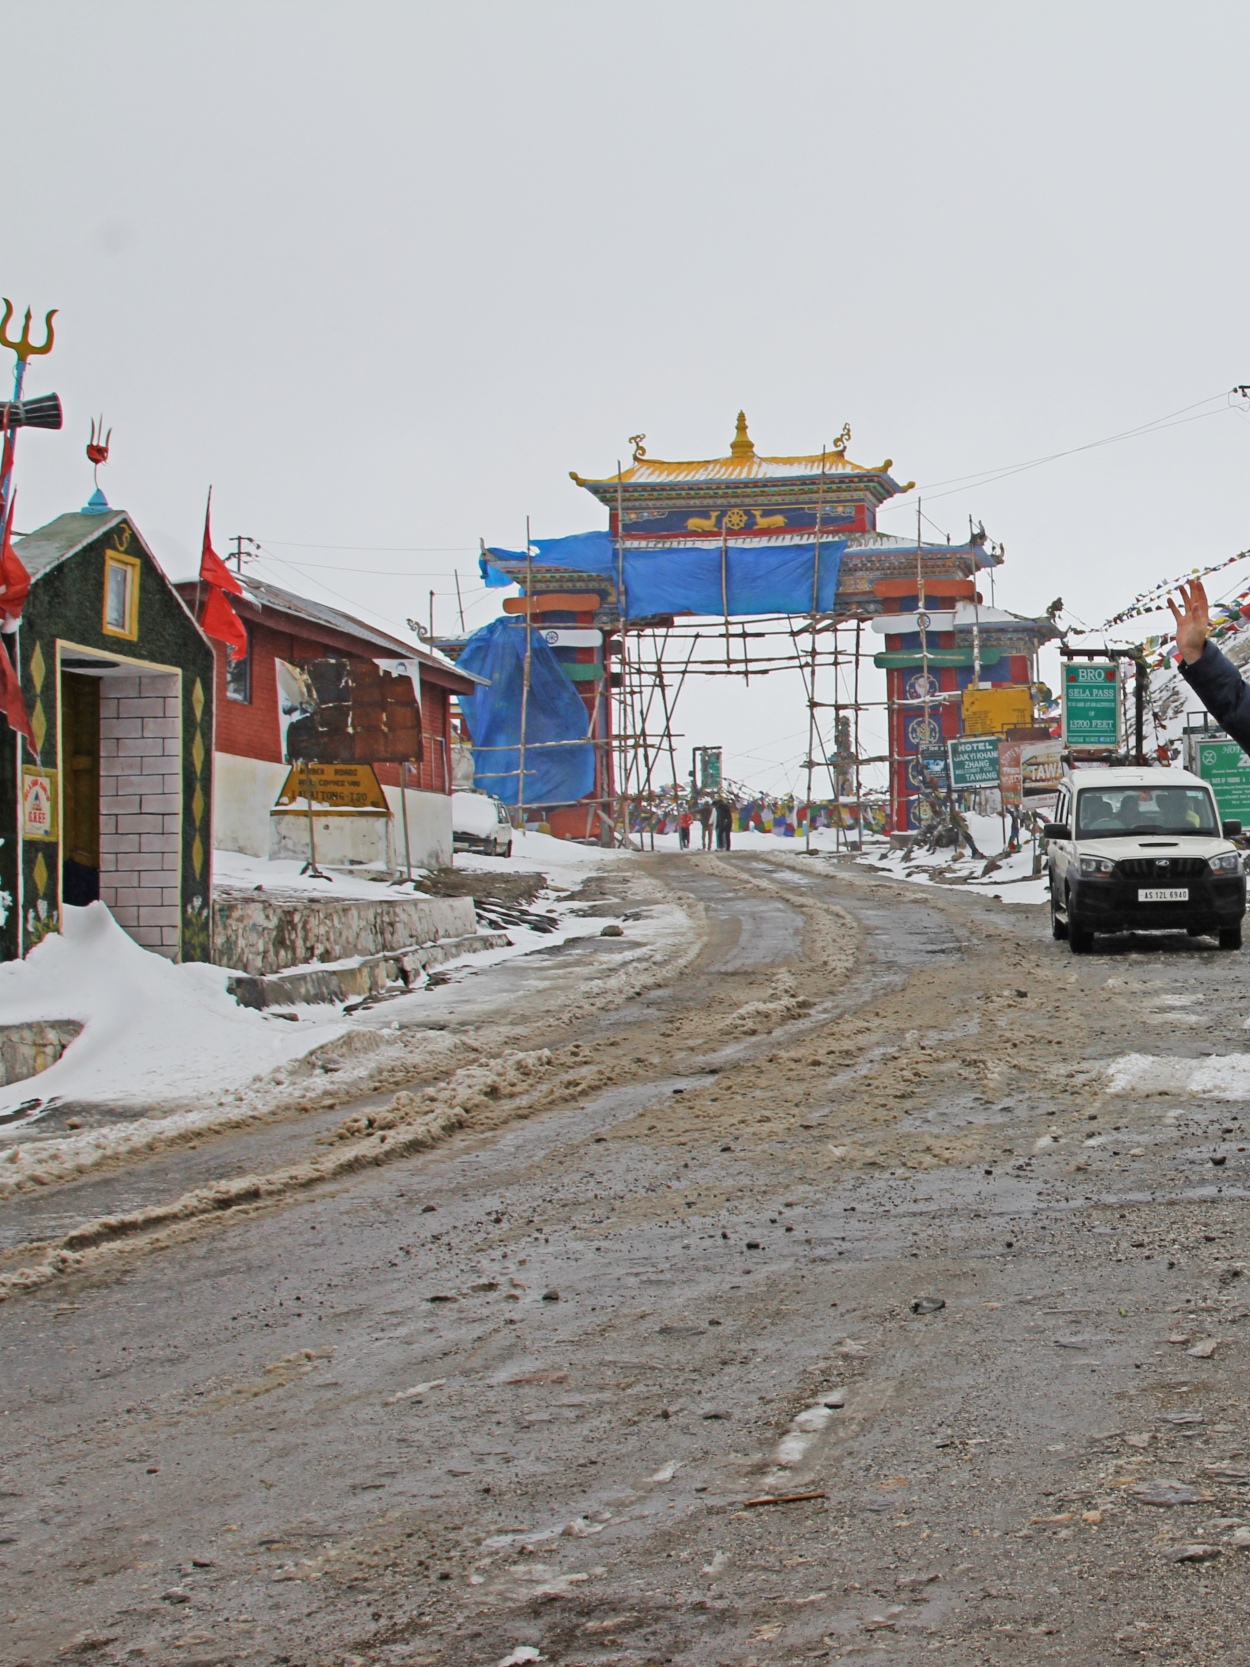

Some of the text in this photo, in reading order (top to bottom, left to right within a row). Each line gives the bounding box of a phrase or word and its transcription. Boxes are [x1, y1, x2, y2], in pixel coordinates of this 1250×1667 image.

[1078, 669, 1104, 681] BRO
[1068, 689, 1114, 697] SELA PASS
[1070, 720, 1114, 728] 13700 FEET
[958, 742, 993, 752] HOTEL
[977, 751, 998, 760] KHAN
[964, 760, 989, 769] ZHANG
[1031, 762, 1063, 780] TAWA
[965, 771, 998, 781] TAWANG
[1144, 890, 1187, 899] AS 12L 6940
